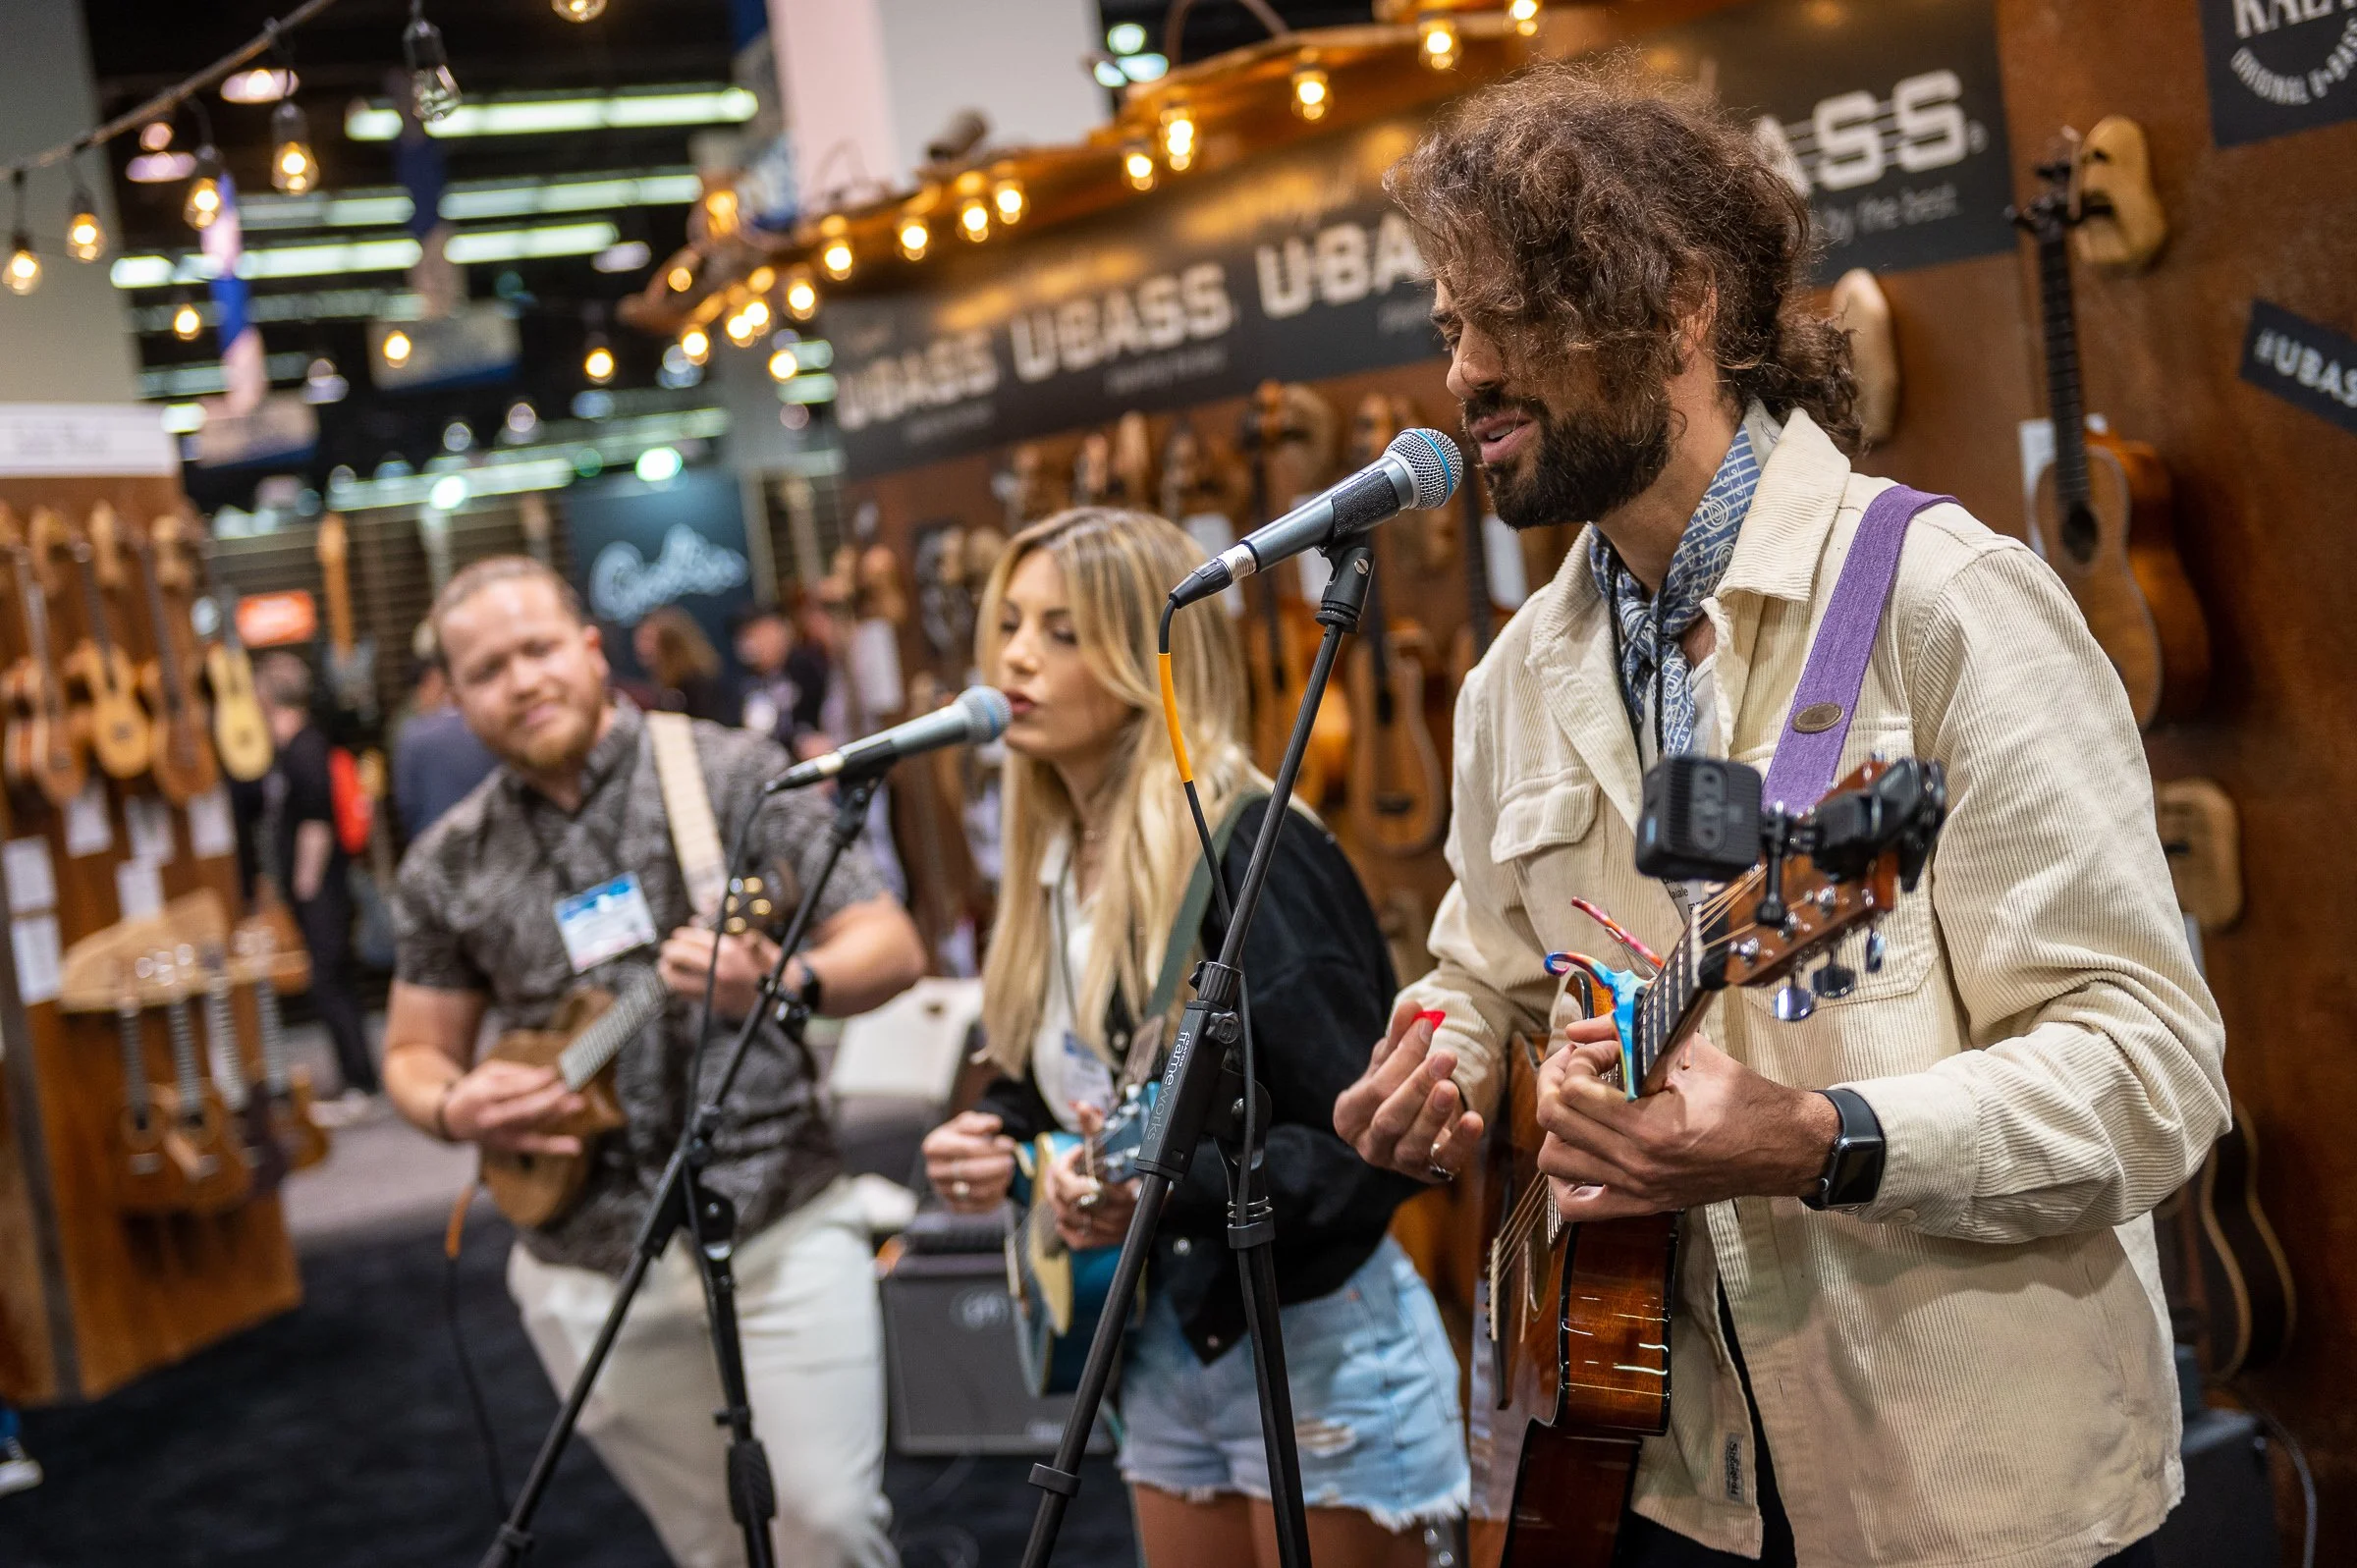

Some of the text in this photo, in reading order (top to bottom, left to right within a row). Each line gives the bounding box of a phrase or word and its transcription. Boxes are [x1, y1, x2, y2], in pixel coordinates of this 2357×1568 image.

[1010, 262, 1233, 384] UBASS
[1669, 887, 1689, 900] aiale
[1147, 1031, 1190, 1141] frameworks
